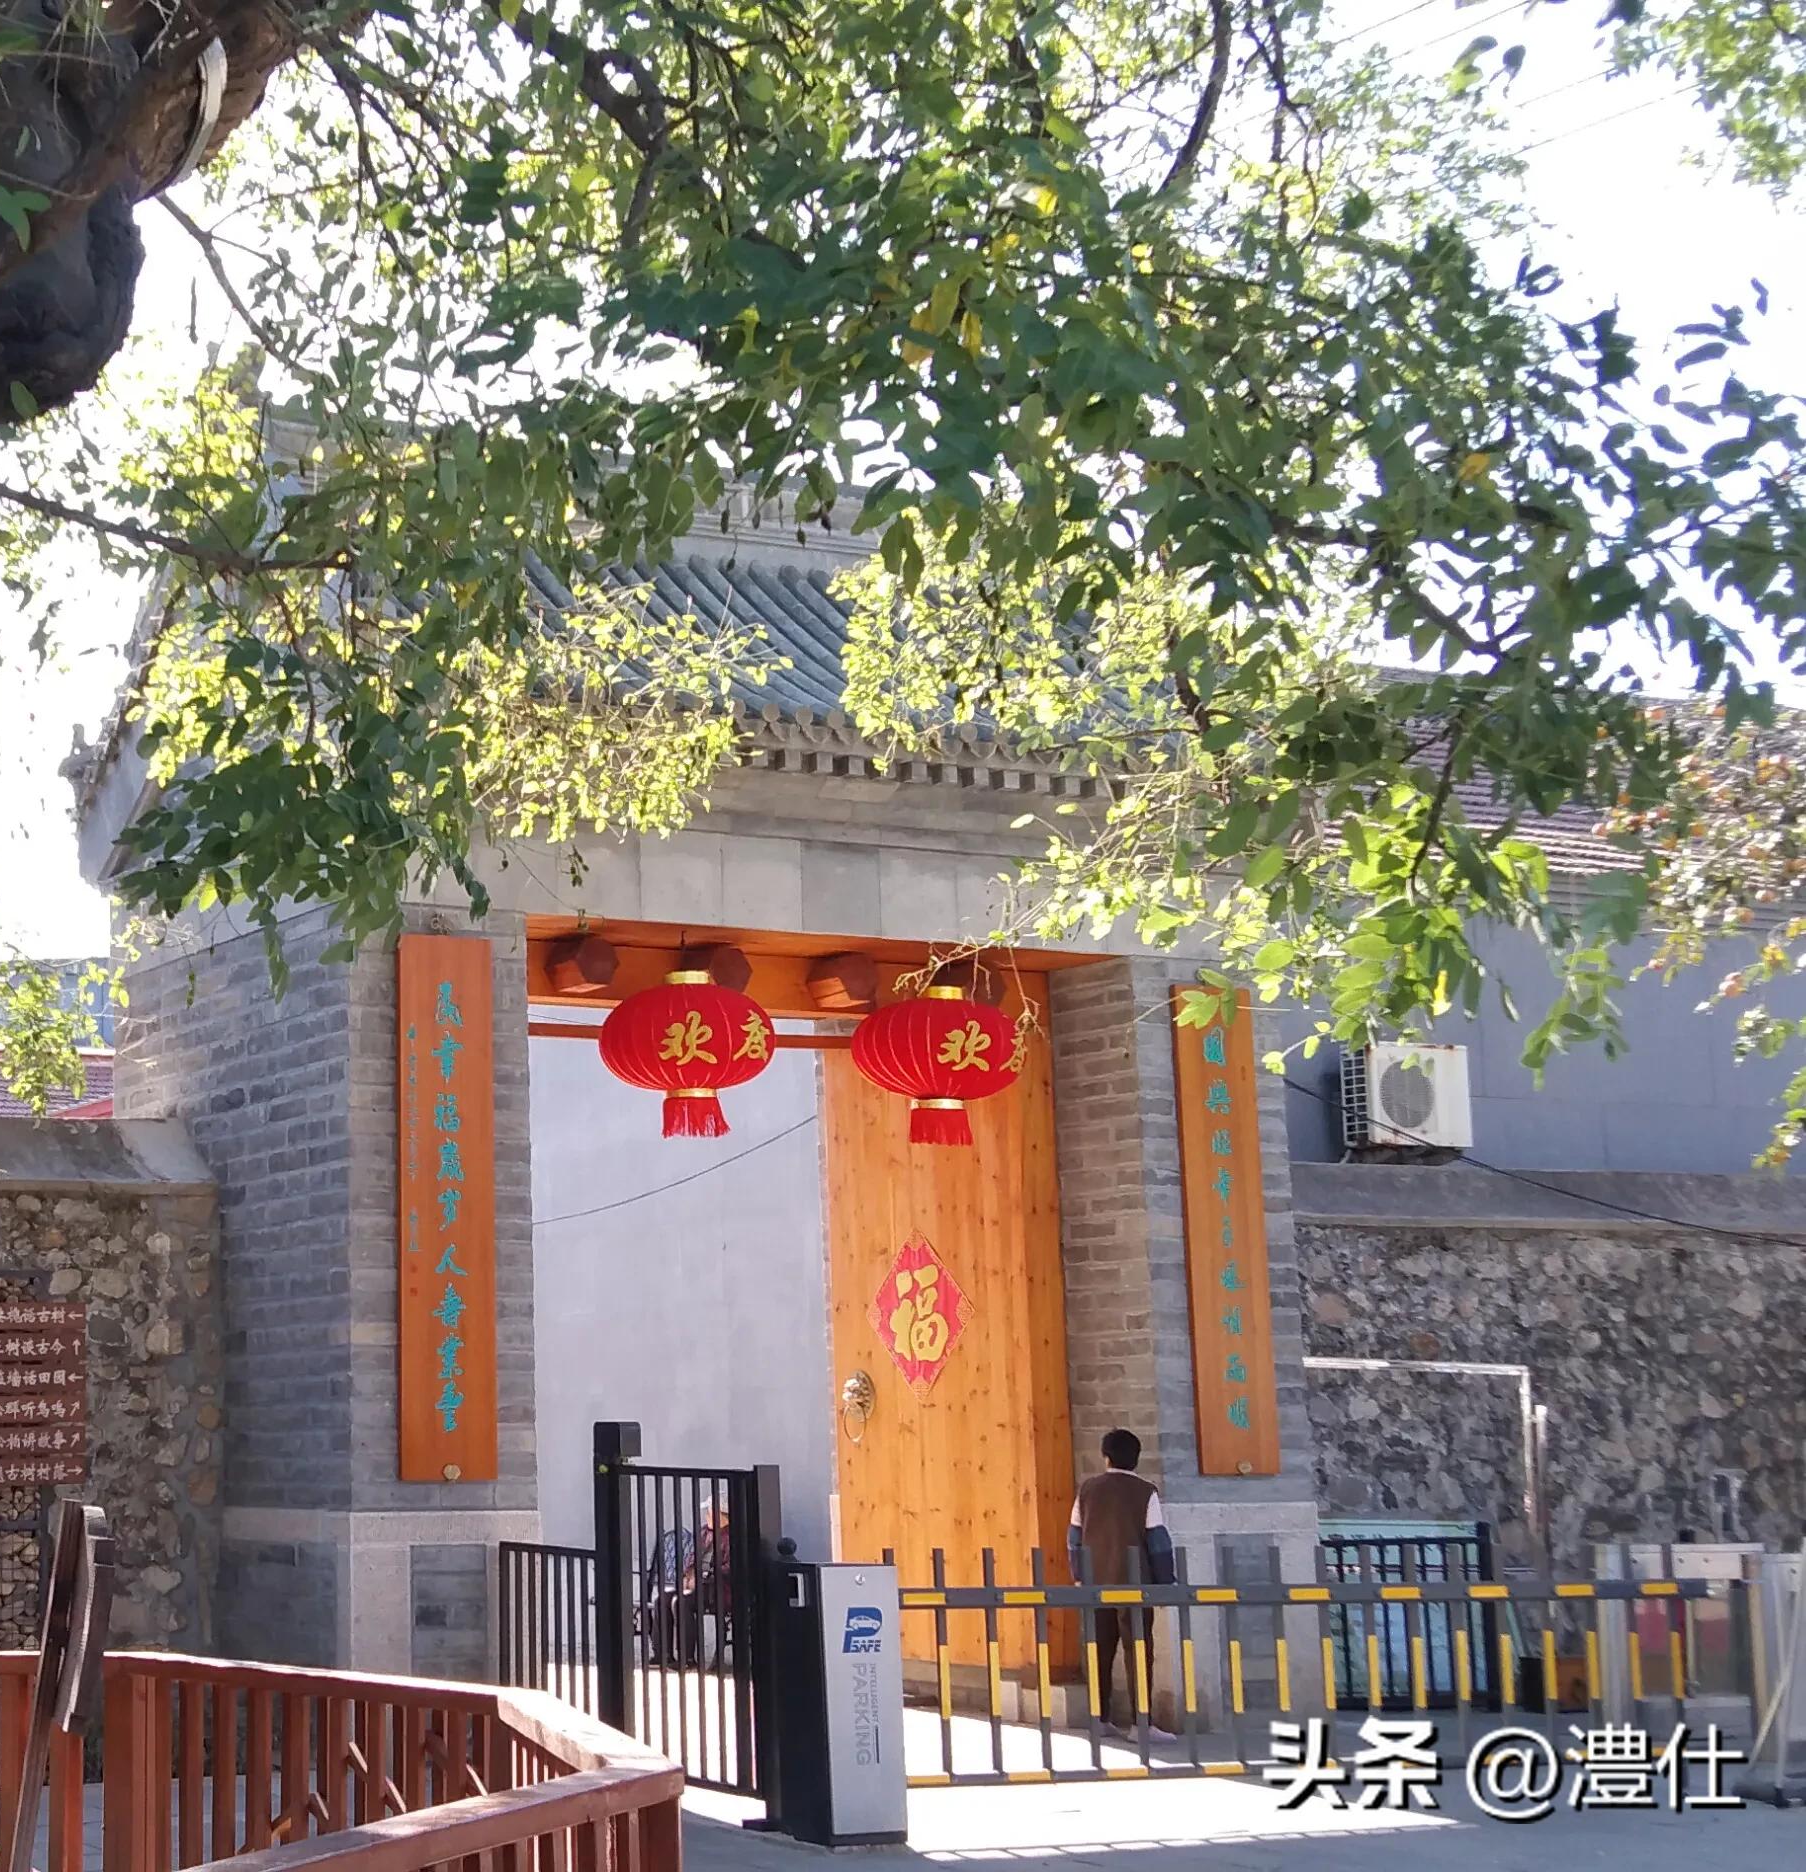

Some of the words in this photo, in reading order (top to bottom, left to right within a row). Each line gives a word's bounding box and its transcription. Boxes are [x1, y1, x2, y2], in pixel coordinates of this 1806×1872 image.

[658, 1009, 770, 1065] 欢度
[889, 1264, 949, 1361] 福
[852, 1663, 873, 1766] PARKING
